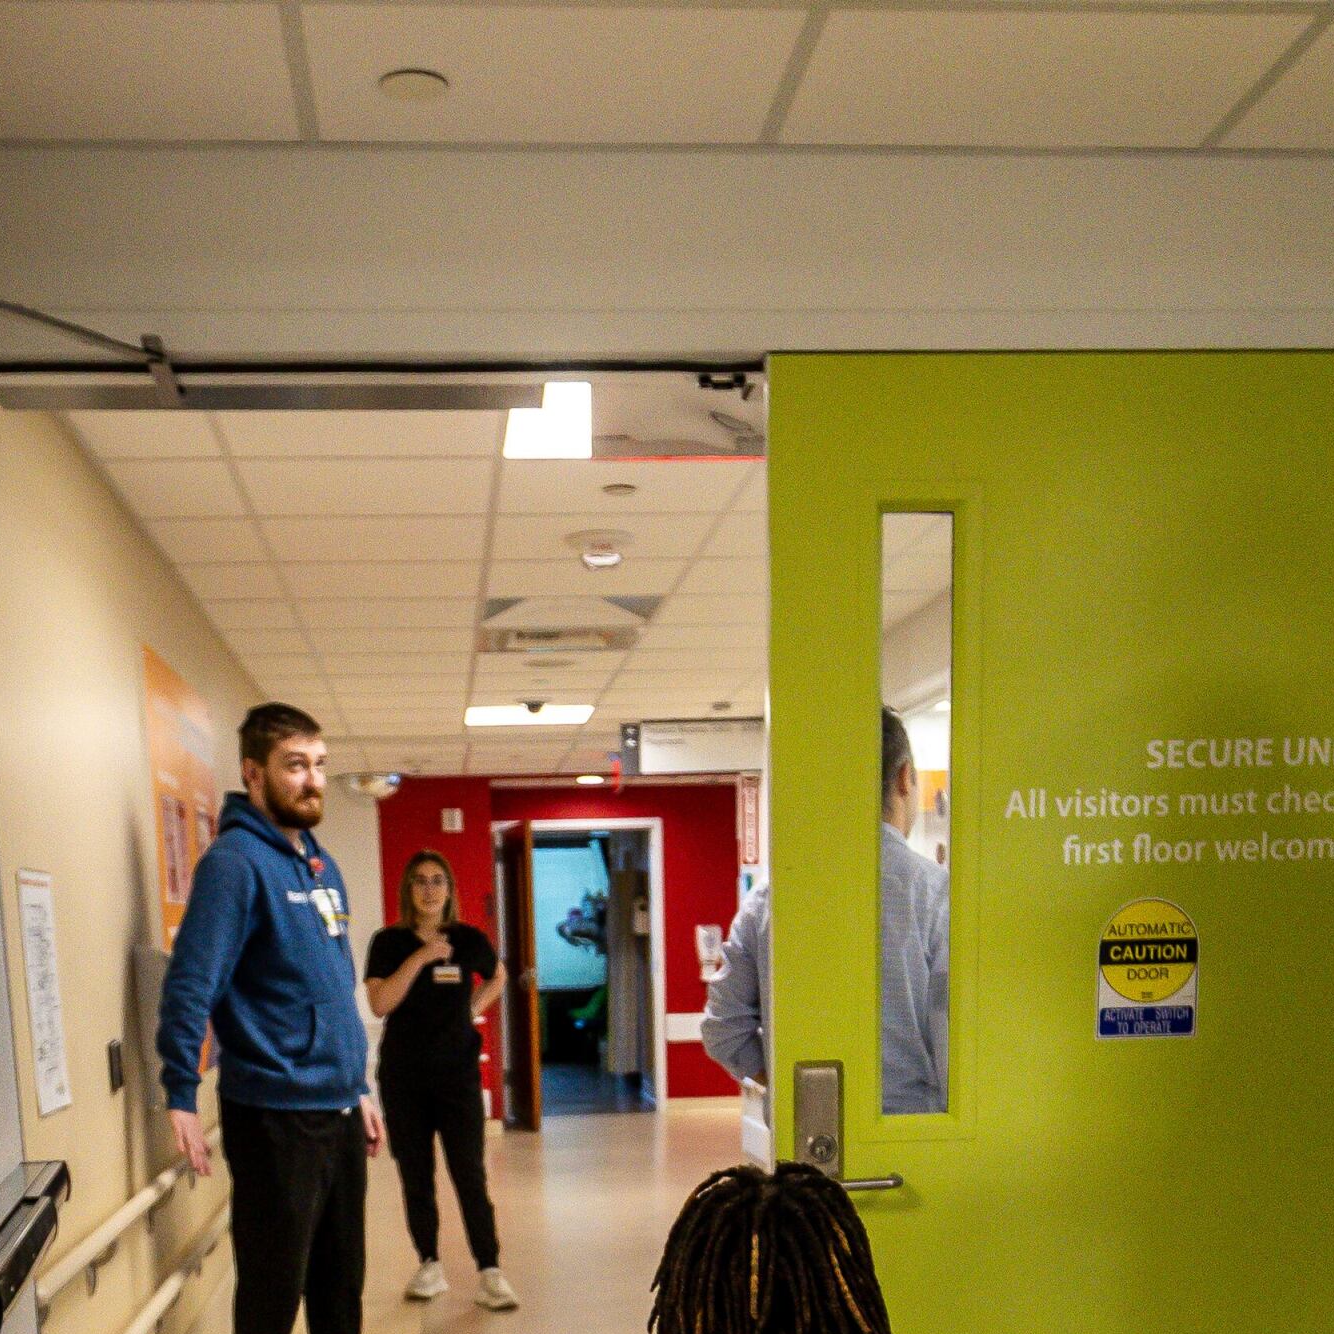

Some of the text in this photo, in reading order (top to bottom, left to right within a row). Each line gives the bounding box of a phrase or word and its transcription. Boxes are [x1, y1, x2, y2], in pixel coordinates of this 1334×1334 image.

[1146, 738, 1273, 769] SECURE
[1003, 787, 1047, 819] All
[1054, 786, 1168, 818] visitors
[1178, 790, 1259, 816] must
[1063, 834, 1125, 866] first
[1131, 832, 1207, 864] floor
[1108, 922, 1191, 936] AUTOMATIC
[1110, 945, 1187, 960] CAUTION
[1126, 967, 1169, 981] DOOR
[1105, 1007, 1189, 1021] ACTIVATE SWITCH
[1117, 1021, 1171, 1034] TO OPERATE
